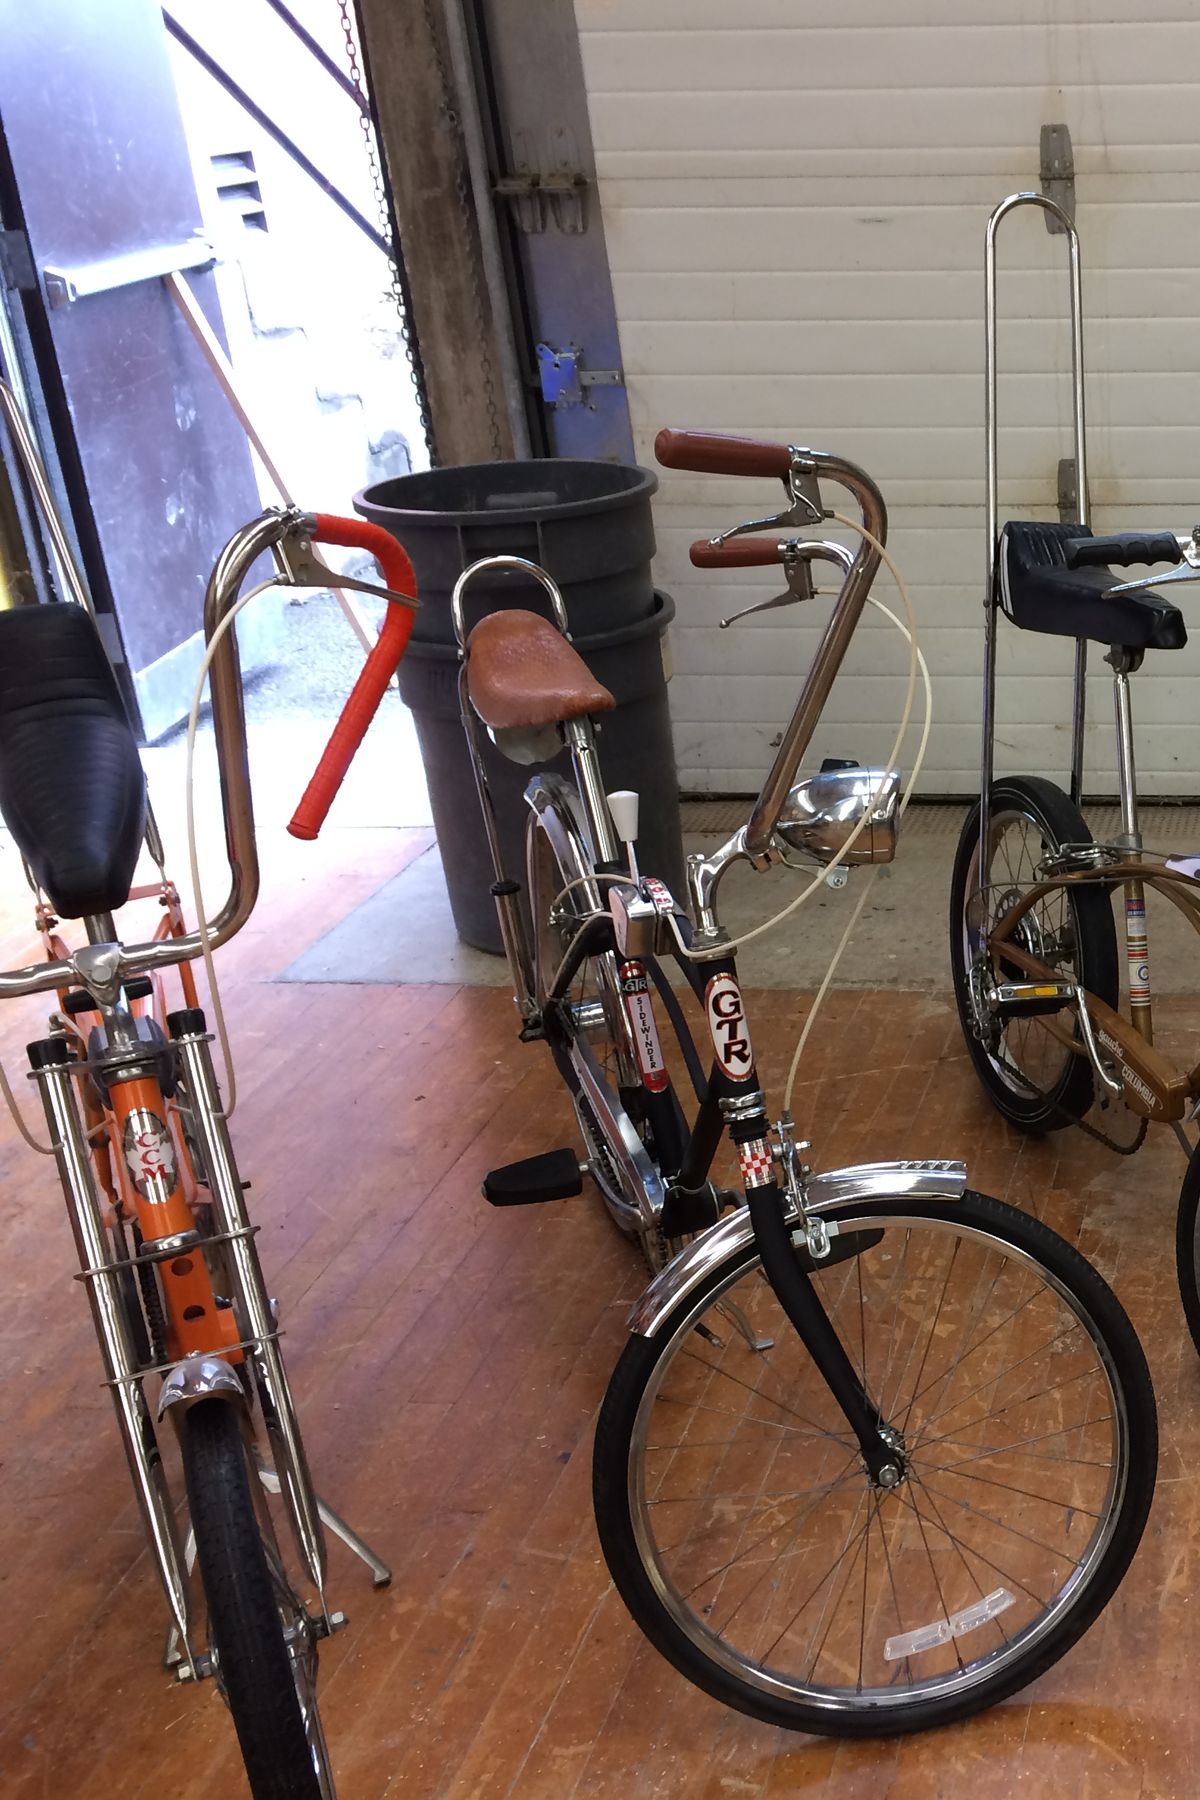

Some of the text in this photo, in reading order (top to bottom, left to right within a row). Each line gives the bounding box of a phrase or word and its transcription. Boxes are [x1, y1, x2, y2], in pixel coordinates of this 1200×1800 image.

[623, 979, 648, 992] GTR
[637, 997, 657, 1069] SIDEWINDER
[712, 990, 751, 1064] GTR
[1121, 1065, 1157, 1108] COLUMBIA
[136, 1131, 167, 1182] CCM
